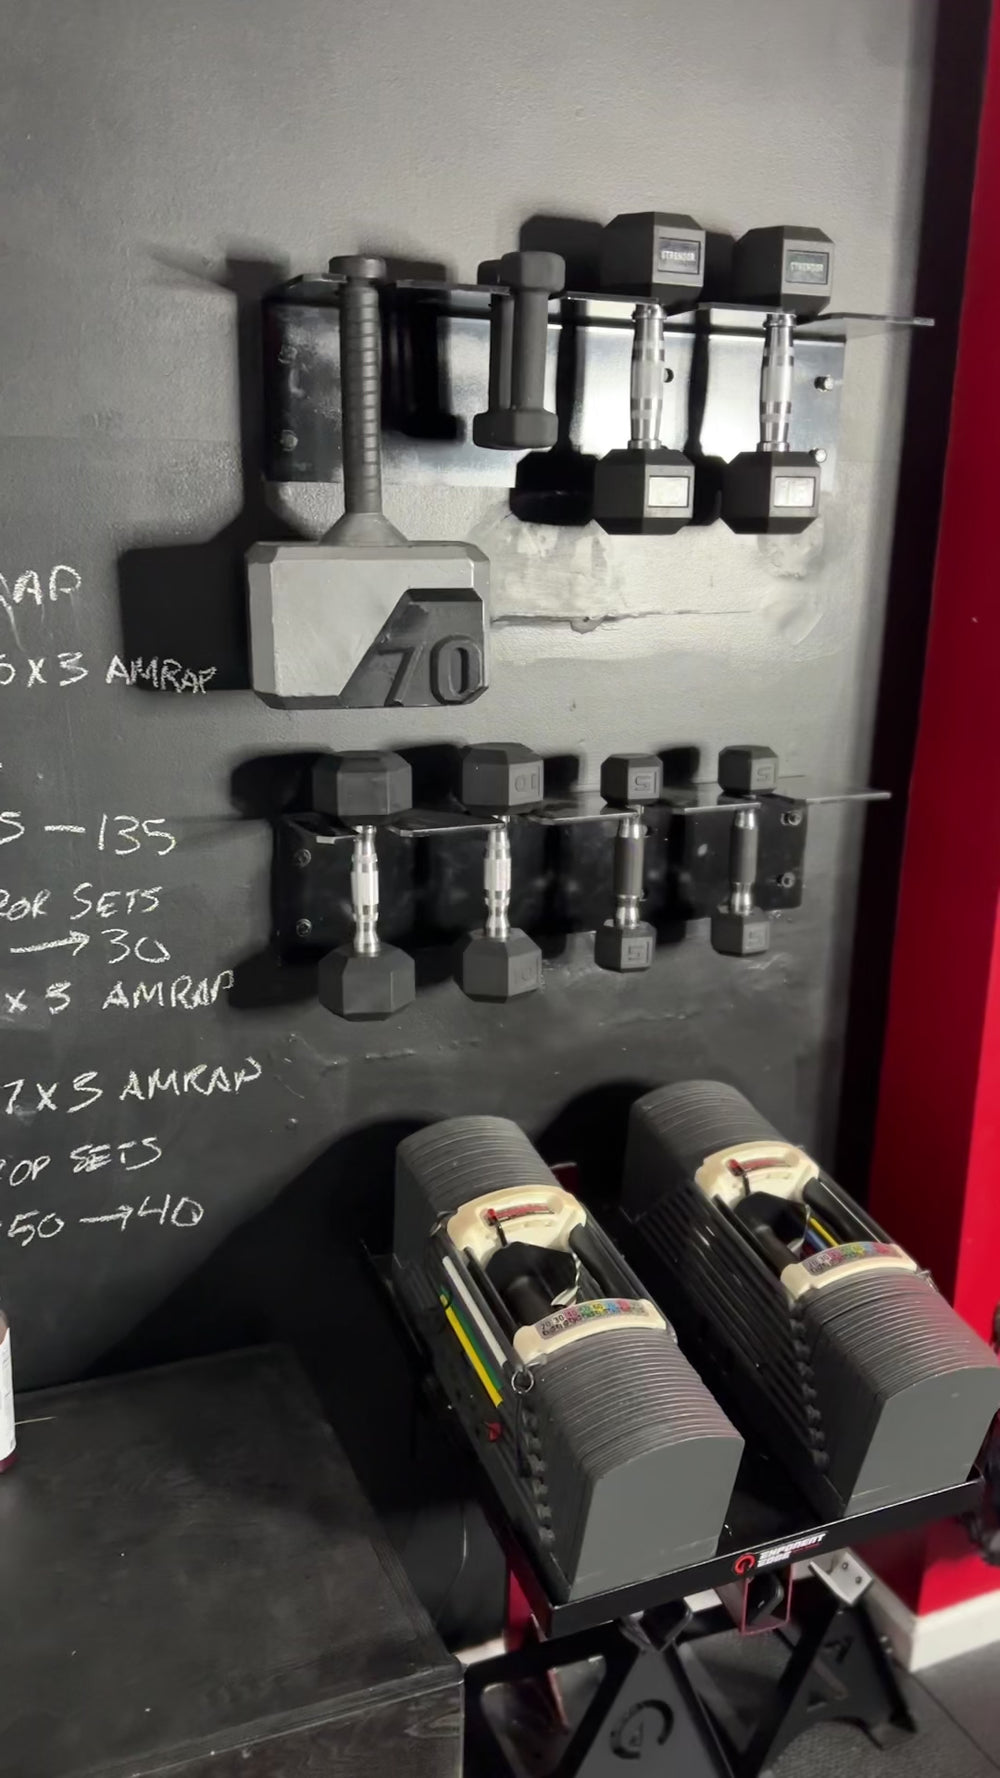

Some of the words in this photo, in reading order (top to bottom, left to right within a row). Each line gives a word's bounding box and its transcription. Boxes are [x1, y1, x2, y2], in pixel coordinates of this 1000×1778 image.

[105, 655, 217, 693] AMRAP
[376, 635, 482, 707] 70
[98, 814, 177, 856] 135
[70, 882, 163, 920] SETS
[101, 928, 171, 964] 30
[119, 1056, 262, 1101] AMRAP
[70, 1137, 162, 1173] SETS
[137, 1194, 204, 1228] 40
